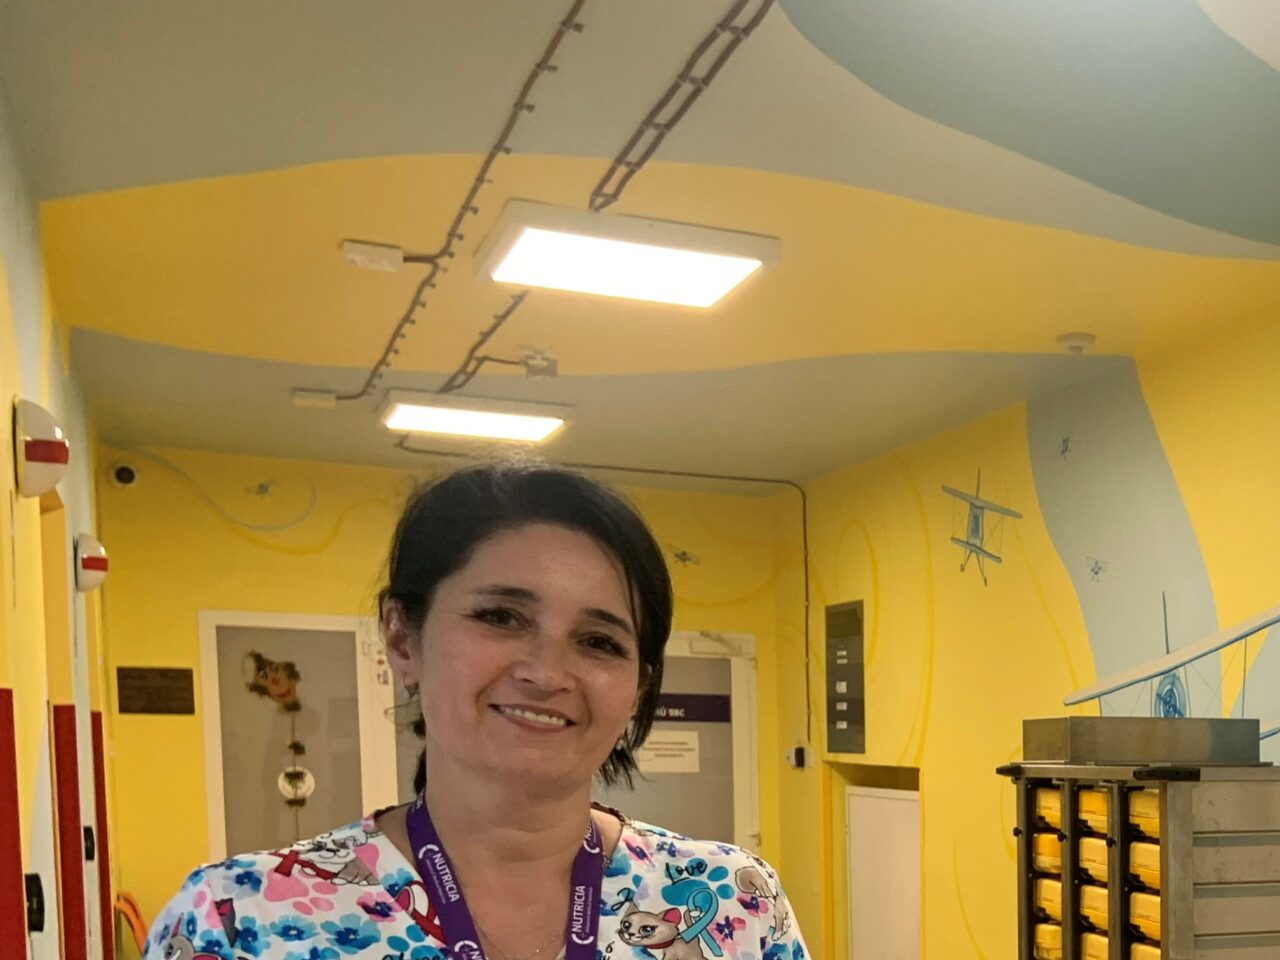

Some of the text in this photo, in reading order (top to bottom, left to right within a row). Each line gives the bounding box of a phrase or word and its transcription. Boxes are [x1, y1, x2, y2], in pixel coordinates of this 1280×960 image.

[433, 853, 460, 902] NUTRICIA
[666, 861, 708, 885] Love
[572, 885, 586, 932] NUTRICIA
